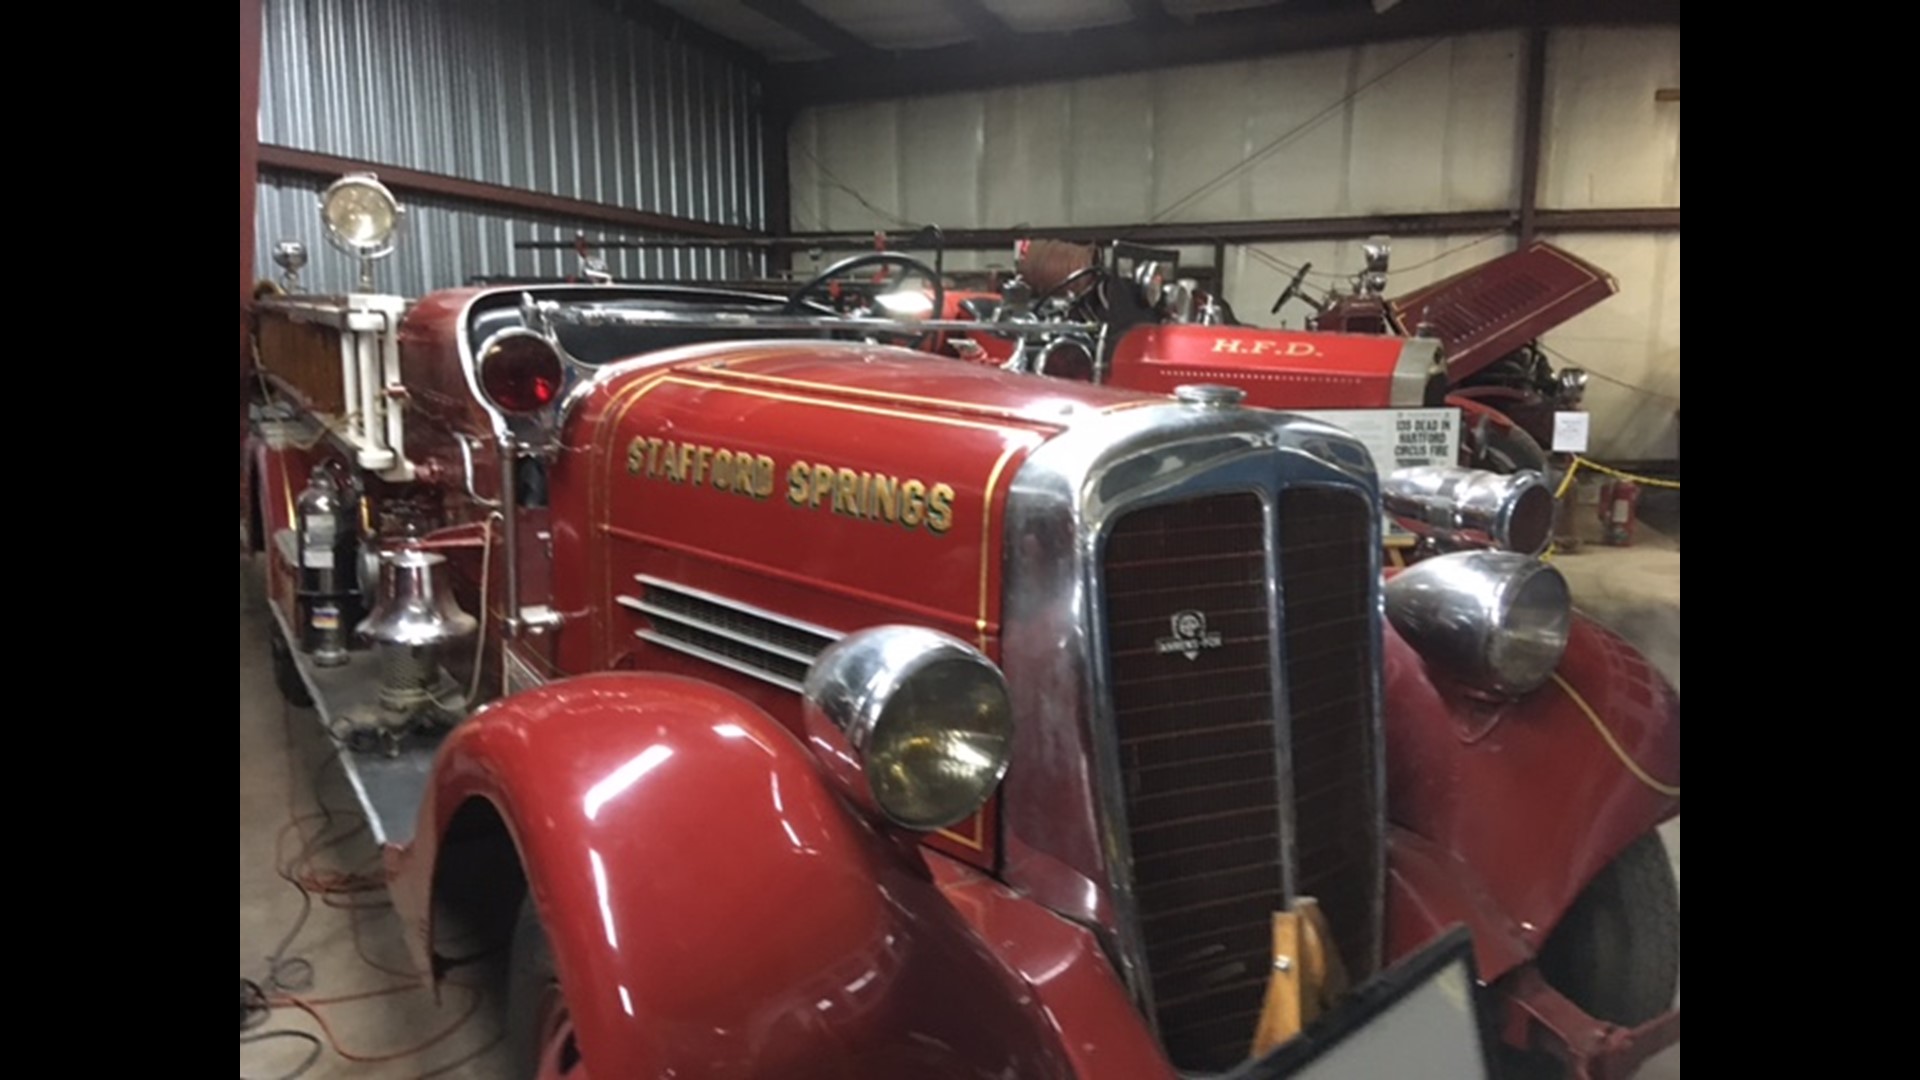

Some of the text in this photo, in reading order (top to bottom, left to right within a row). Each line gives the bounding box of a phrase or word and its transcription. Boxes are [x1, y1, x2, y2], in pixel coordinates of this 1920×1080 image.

[1211, 338, 1323, 356] H.F.D.
[1414, 420, 1438, 431] DEAD
[1441, 420, 1451, 431] IN
[1399, 432, 1446, 444] HARTFORD
[1394, 445, 1449, 457] CIRCUS FIRE
[627, 434, 956, 535] STAFFORD SPRINGS
